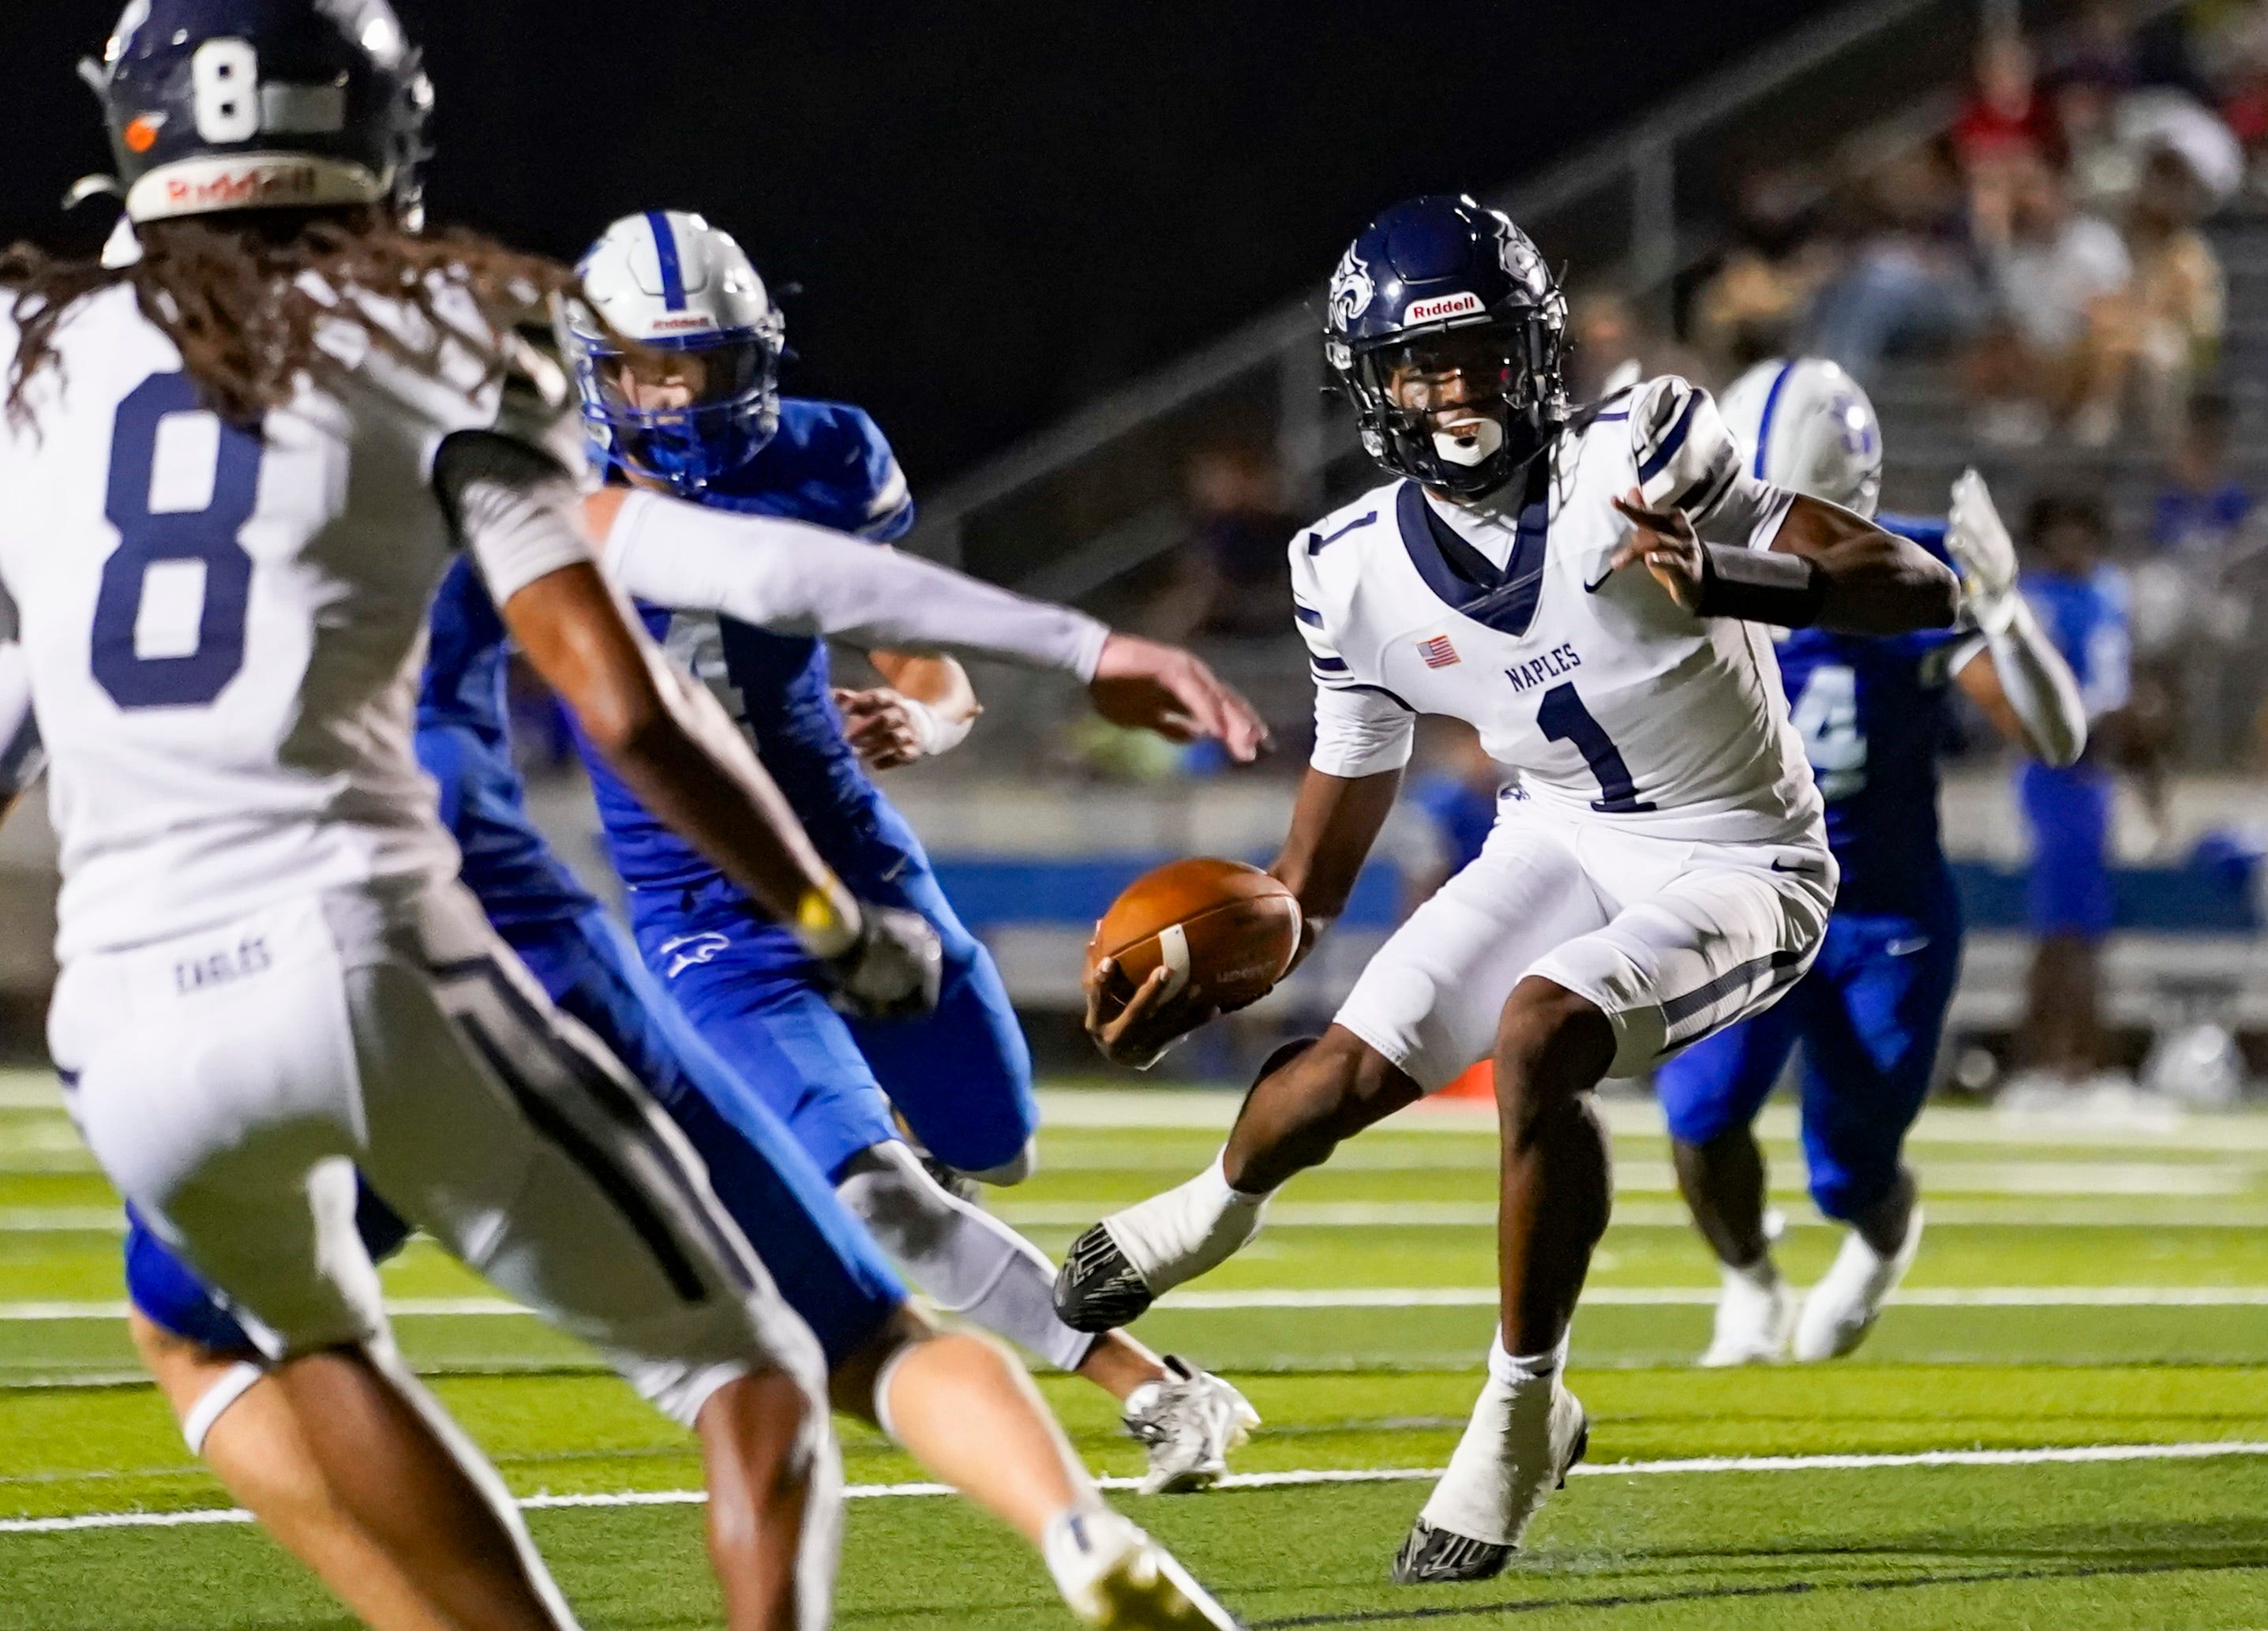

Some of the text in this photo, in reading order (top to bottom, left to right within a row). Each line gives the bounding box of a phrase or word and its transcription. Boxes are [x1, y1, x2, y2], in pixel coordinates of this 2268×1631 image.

[192, 37, 259, 144] 8
[1413, 296, 1475, 318] Riddell
[91, 372, 263, 712] 8
[1505, 643, 1581, 692] NAPLES
[1536, 681, 1657, 812] 1
